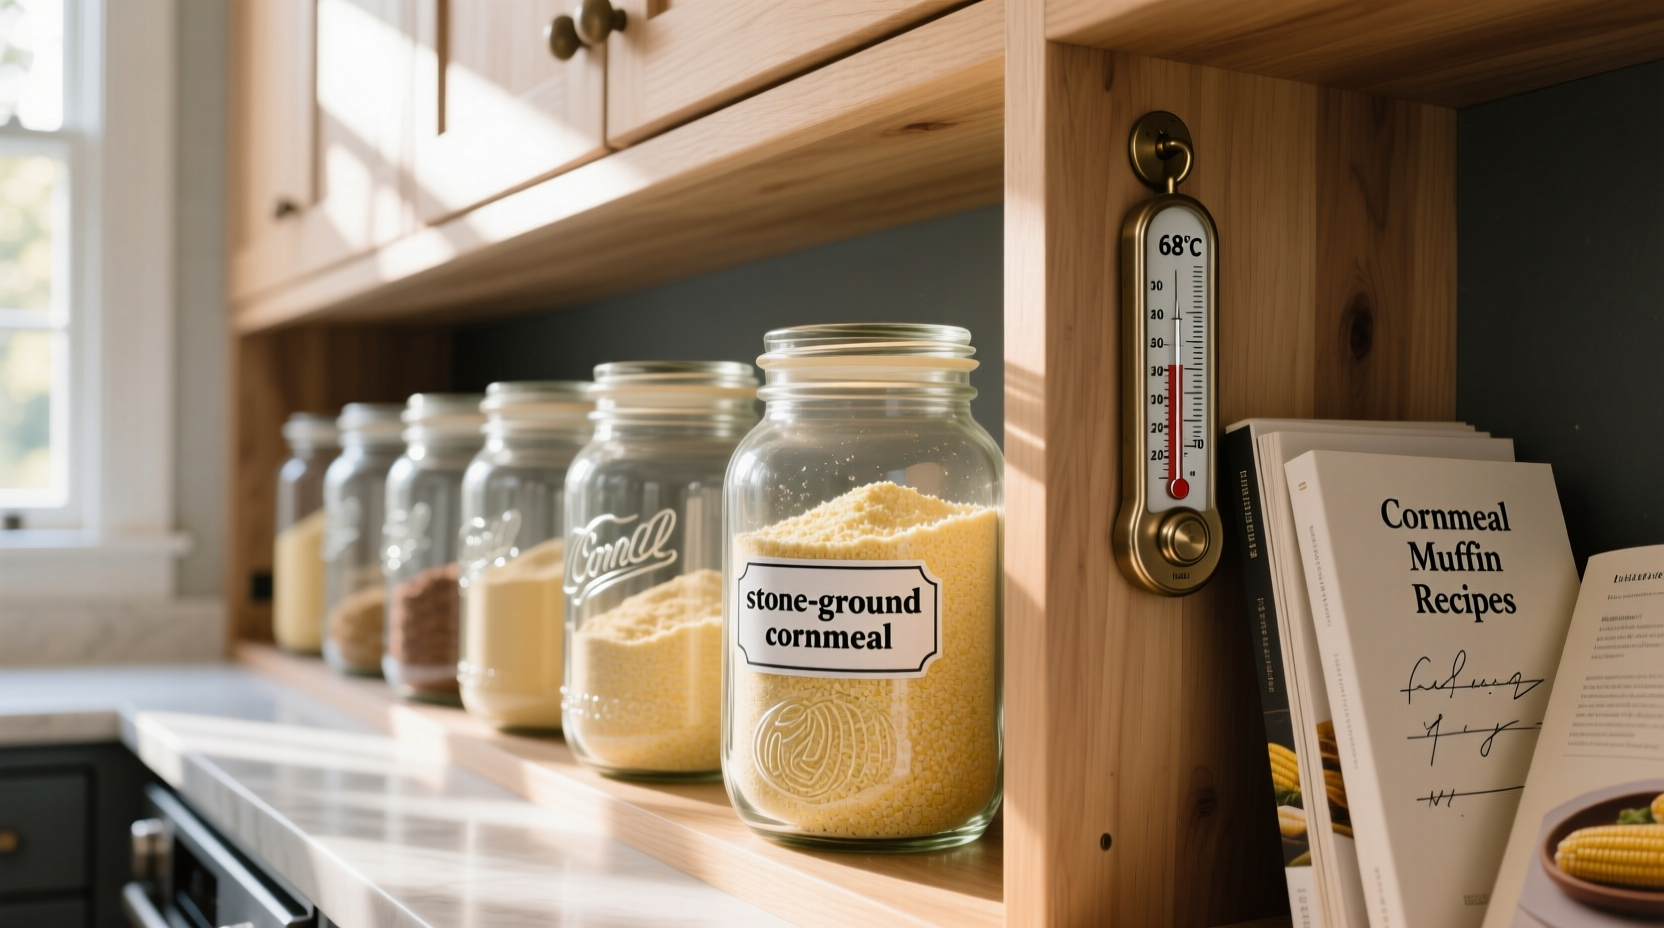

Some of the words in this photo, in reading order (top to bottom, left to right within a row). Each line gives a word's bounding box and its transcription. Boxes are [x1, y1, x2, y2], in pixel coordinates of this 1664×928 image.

[1159, 234, 1203, 258] 68°C
[1150, 449, 1164, 461] 20
[1381, 498, 1512, 532] Cornmeal
[1407, 540, 1504, 572] Muffin
[746, 587, 922, 622] stone-ground
[1411, 583, 1517, 623] Recipes
[765, 622, 893, 650] cornmeal
